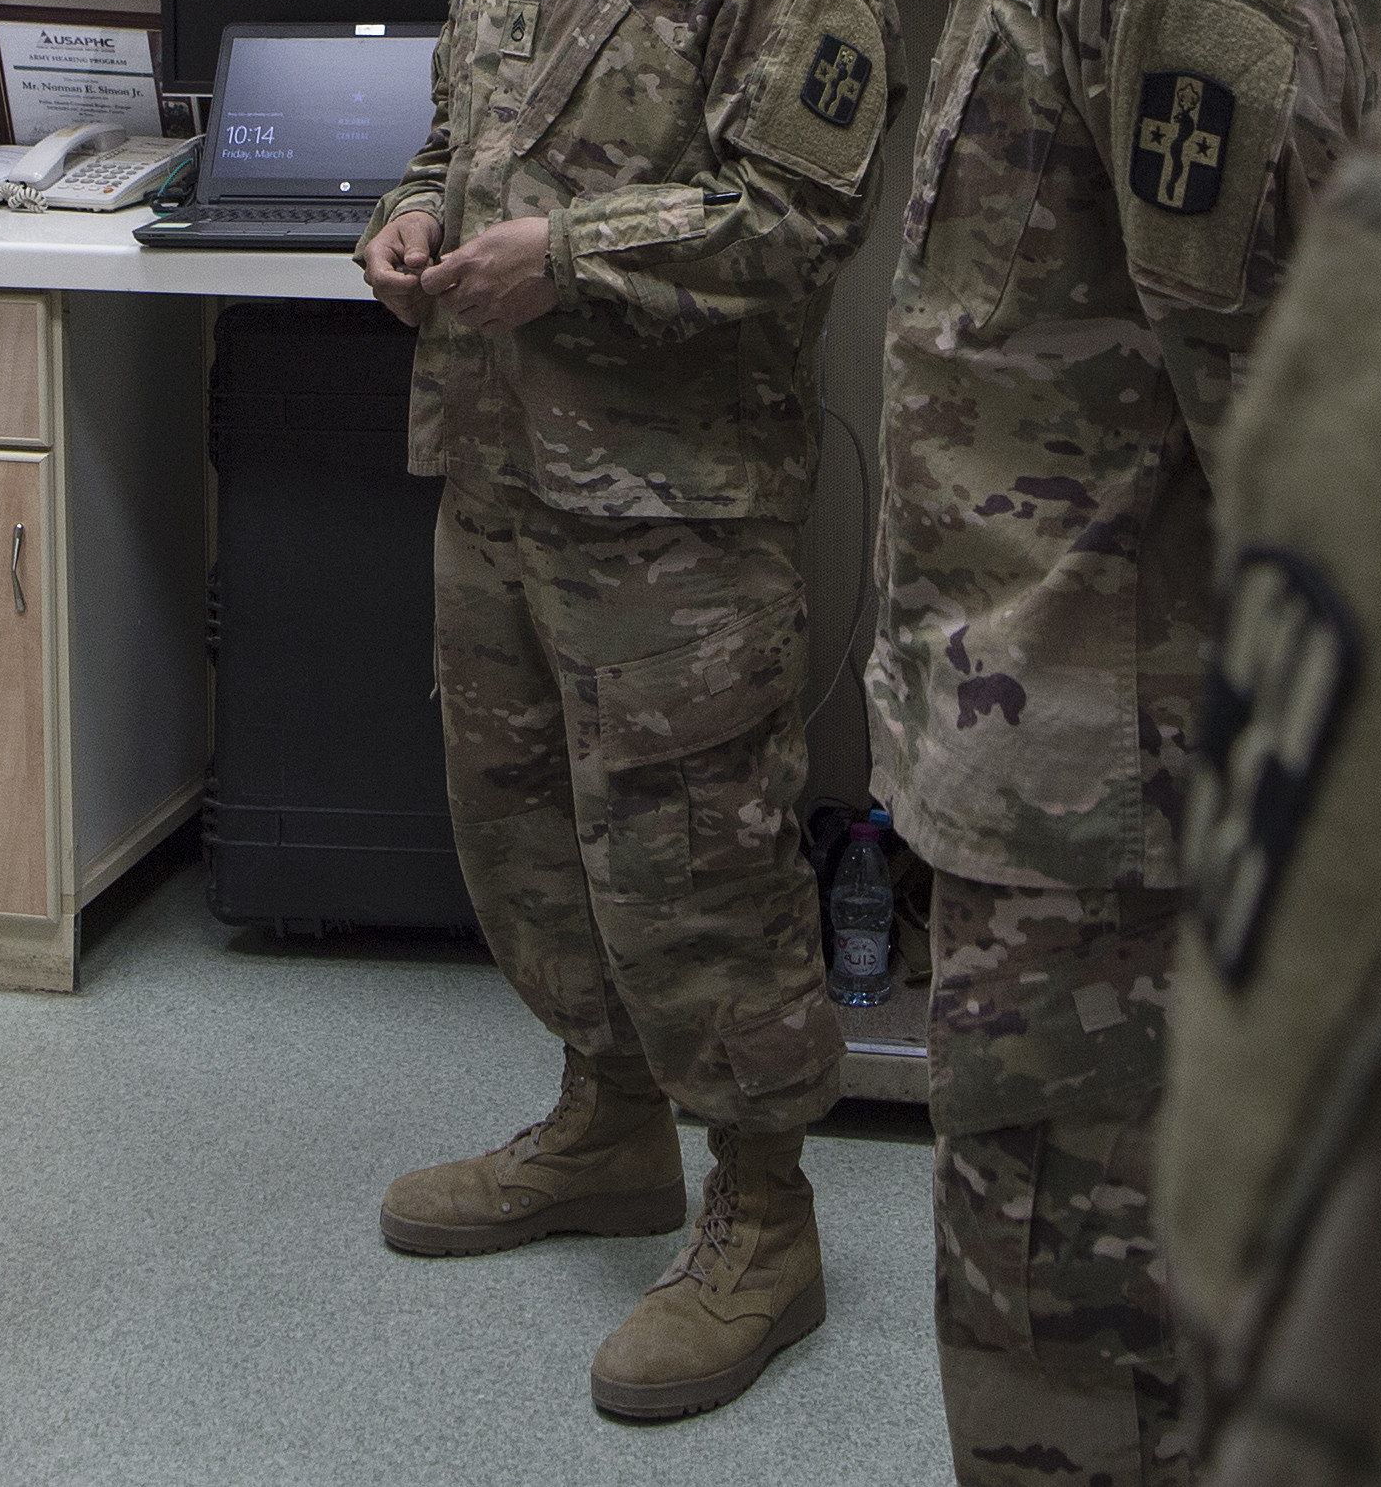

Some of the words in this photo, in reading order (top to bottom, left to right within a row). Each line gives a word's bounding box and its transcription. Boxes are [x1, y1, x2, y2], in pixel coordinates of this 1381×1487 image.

[54, 36, 115, 48] USAPHC
[29, 54, 50, 62] ARMY
[89, 58, 127, 66] PROGRAM
[22, 81, 39, 90] Mr.
[41, 82, 82, 93] Norman
[98, 85, 129, 96] Simon
[226, 125, 275, 144] 10:14
[222, 149, 251, 161] Friday,
[255, 149, 284, 159] March
[286, 149, 294, 159] 8
